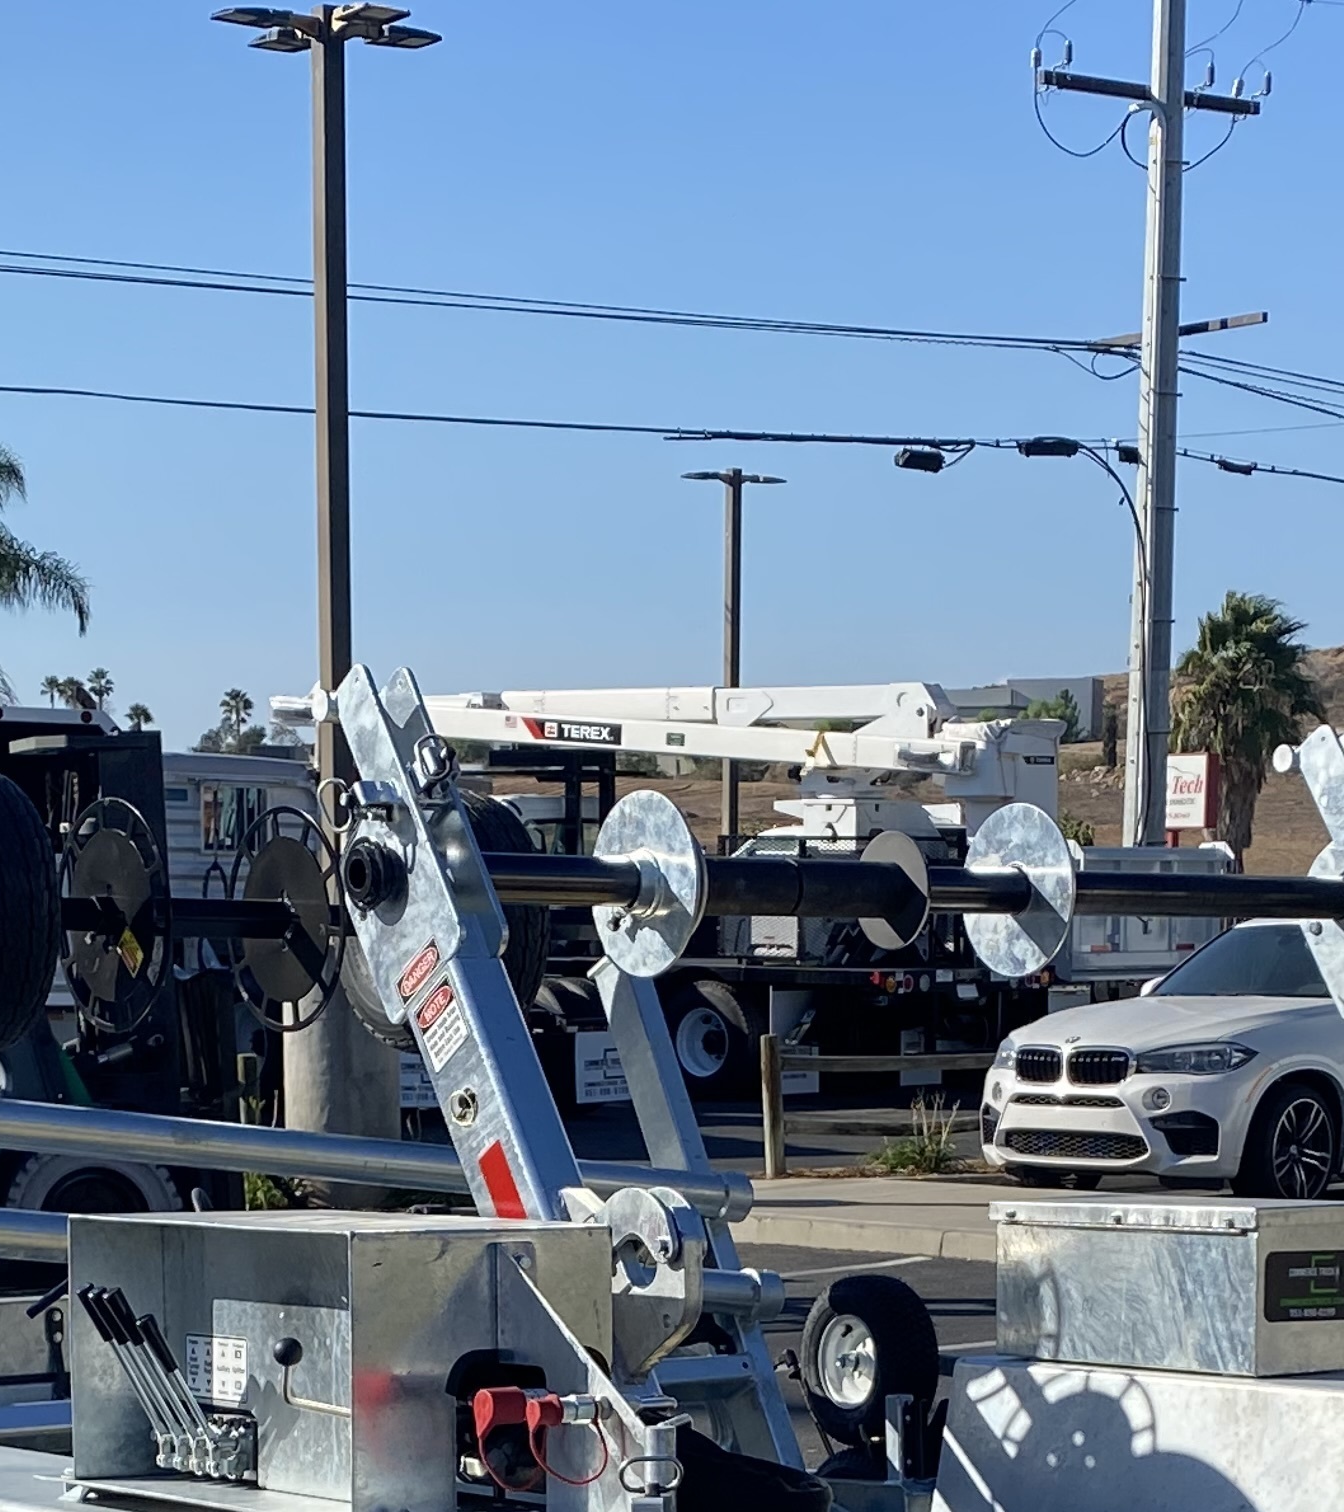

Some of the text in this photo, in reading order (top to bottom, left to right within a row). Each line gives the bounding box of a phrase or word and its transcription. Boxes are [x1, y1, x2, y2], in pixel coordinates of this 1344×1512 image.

[561, 723, 611, 740] TEREX
[1172, 774, 1203, 795] Tech
[404, 950, 435, 991] DANGER
[424, 993, 447, 1021] NOTE
